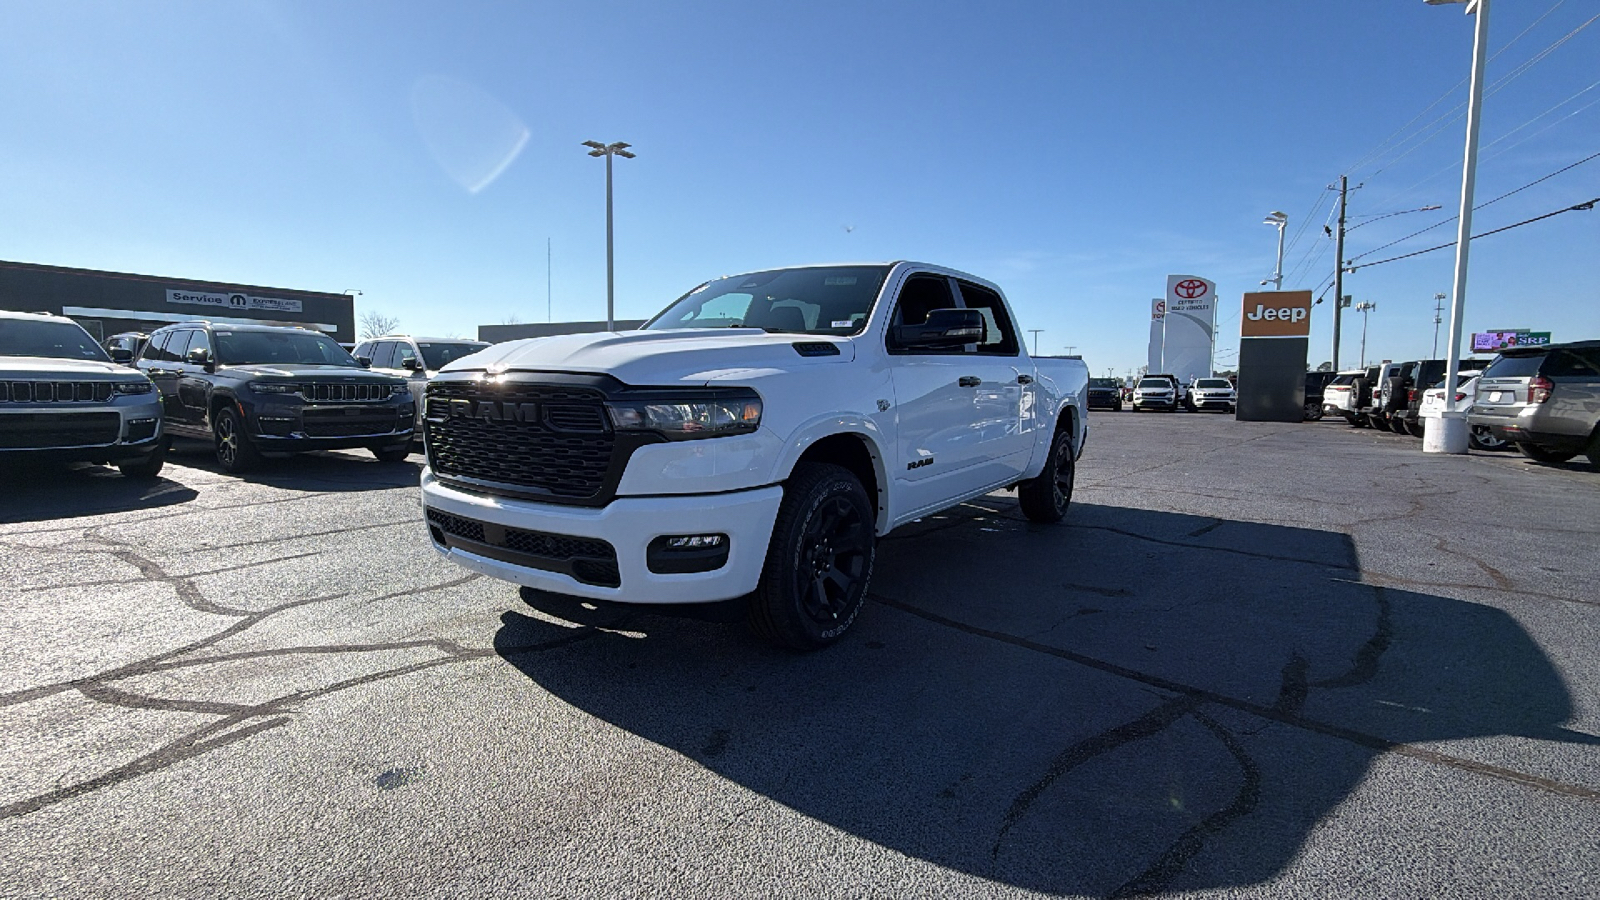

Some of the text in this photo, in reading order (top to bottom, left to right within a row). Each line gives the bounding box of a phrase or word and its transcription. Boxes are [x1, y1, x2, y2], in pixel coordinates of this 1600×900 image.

[172, 292, 223, 304] Service
[1247, 304, 1307, 323] Jeep
[1518, 336, 1548, 344] SRP
[450, 399, 538, 423] RAM
[907, 457, 934, 470] RAM
